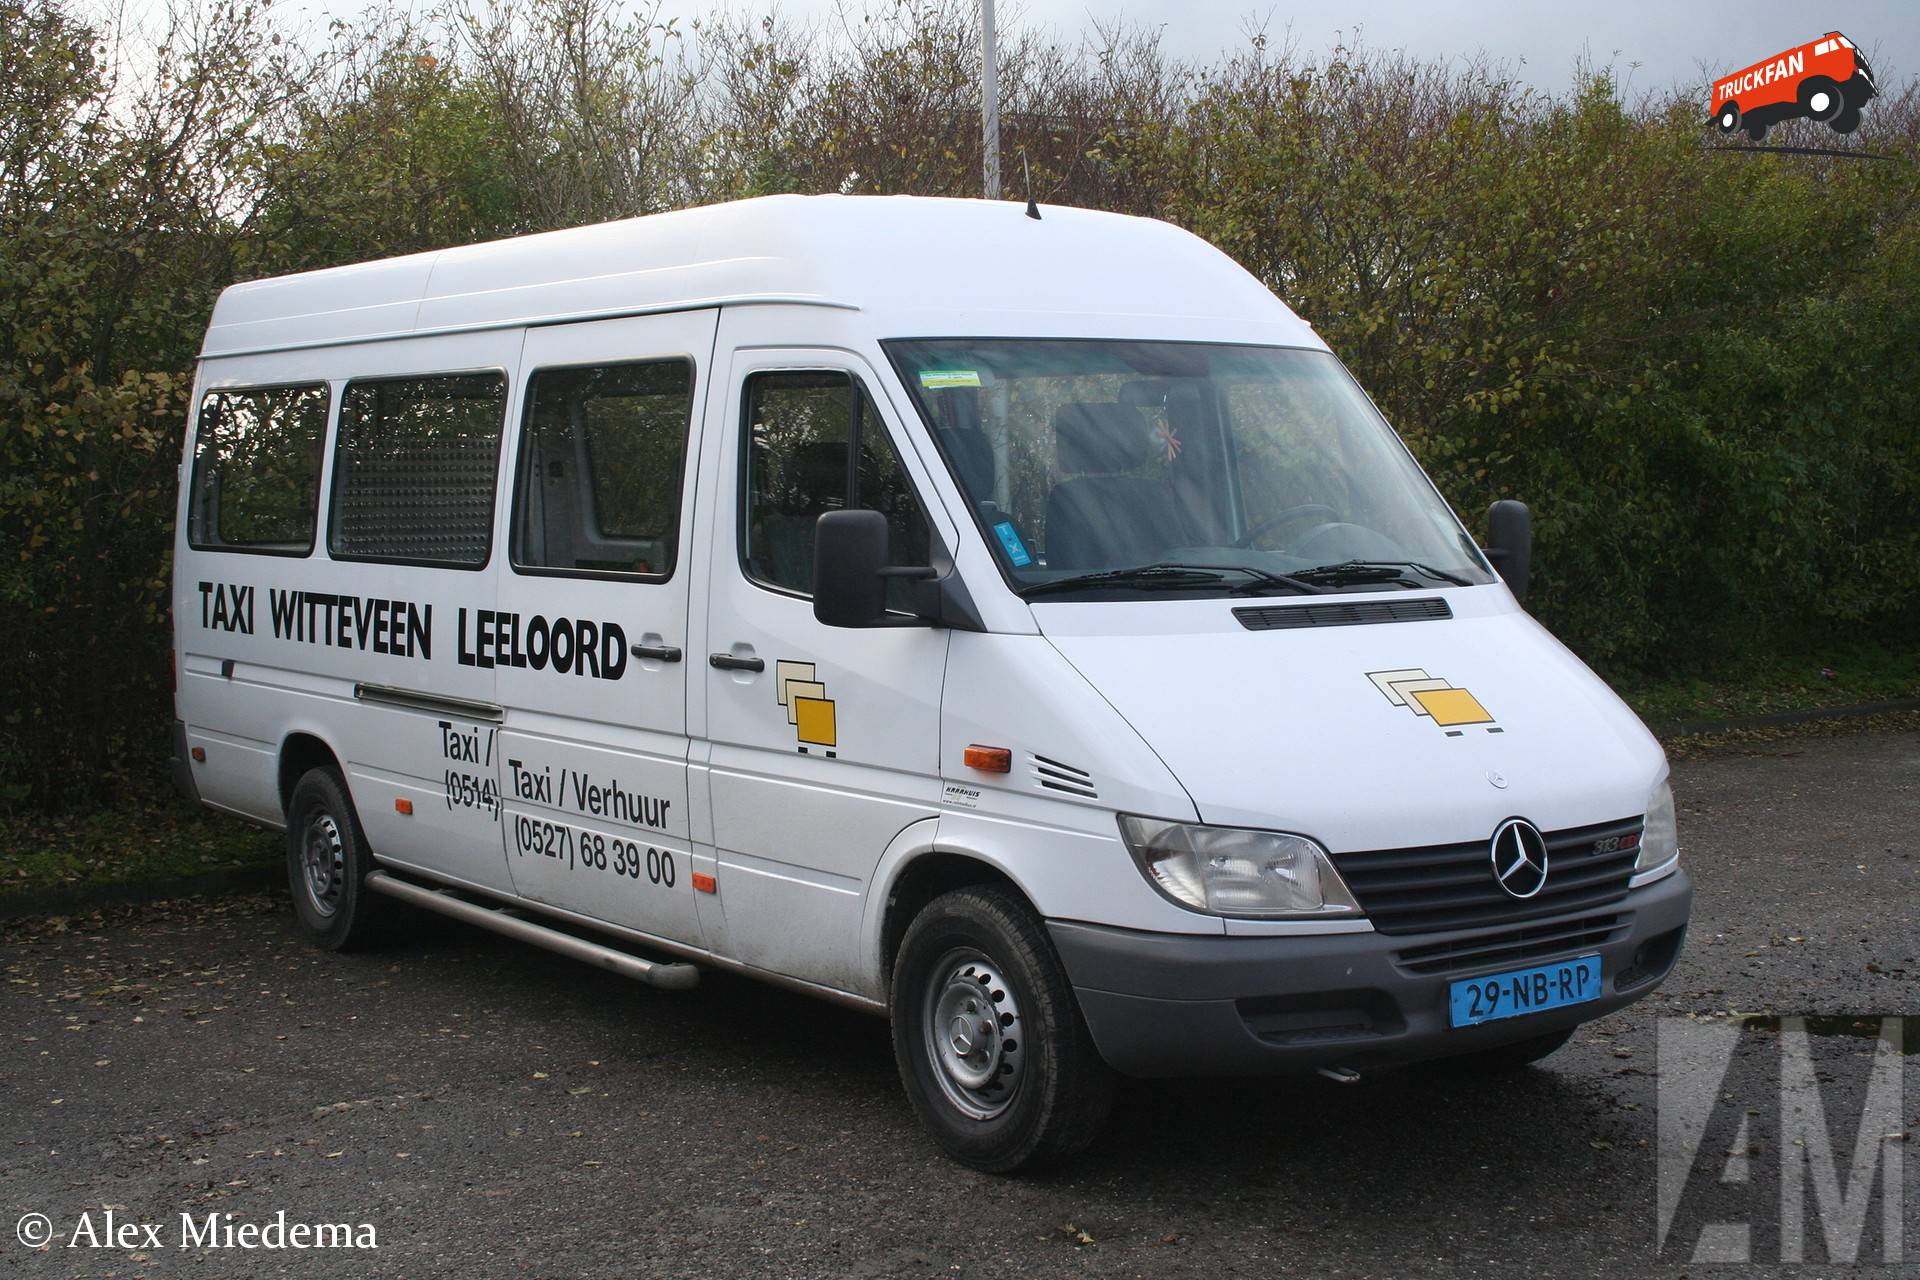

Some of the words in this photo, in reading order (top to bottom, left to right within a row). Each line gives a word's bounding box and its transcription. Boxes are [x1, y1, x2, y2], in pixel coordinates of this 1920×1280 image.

[198, 580, 255, 635] TAXI
[269, 588, 433, 660] WITTEVEEN
[457, 607, 628, 681] LEELOORD
[438, 721, 480, 764] Taxi
[444, 768, 500, 822] (0514)
[508, 759, 552, 804] Taxi
[571, 771, 671, 830] Verhuur
[514, 814, 575, 871] (0527)
[580, 831, 608, 871] 68
[612, 839, 641, 880] 39
[646, 847, 676, 889] 00
[1466, 964, 1590, 1018] 29-NB-RP
